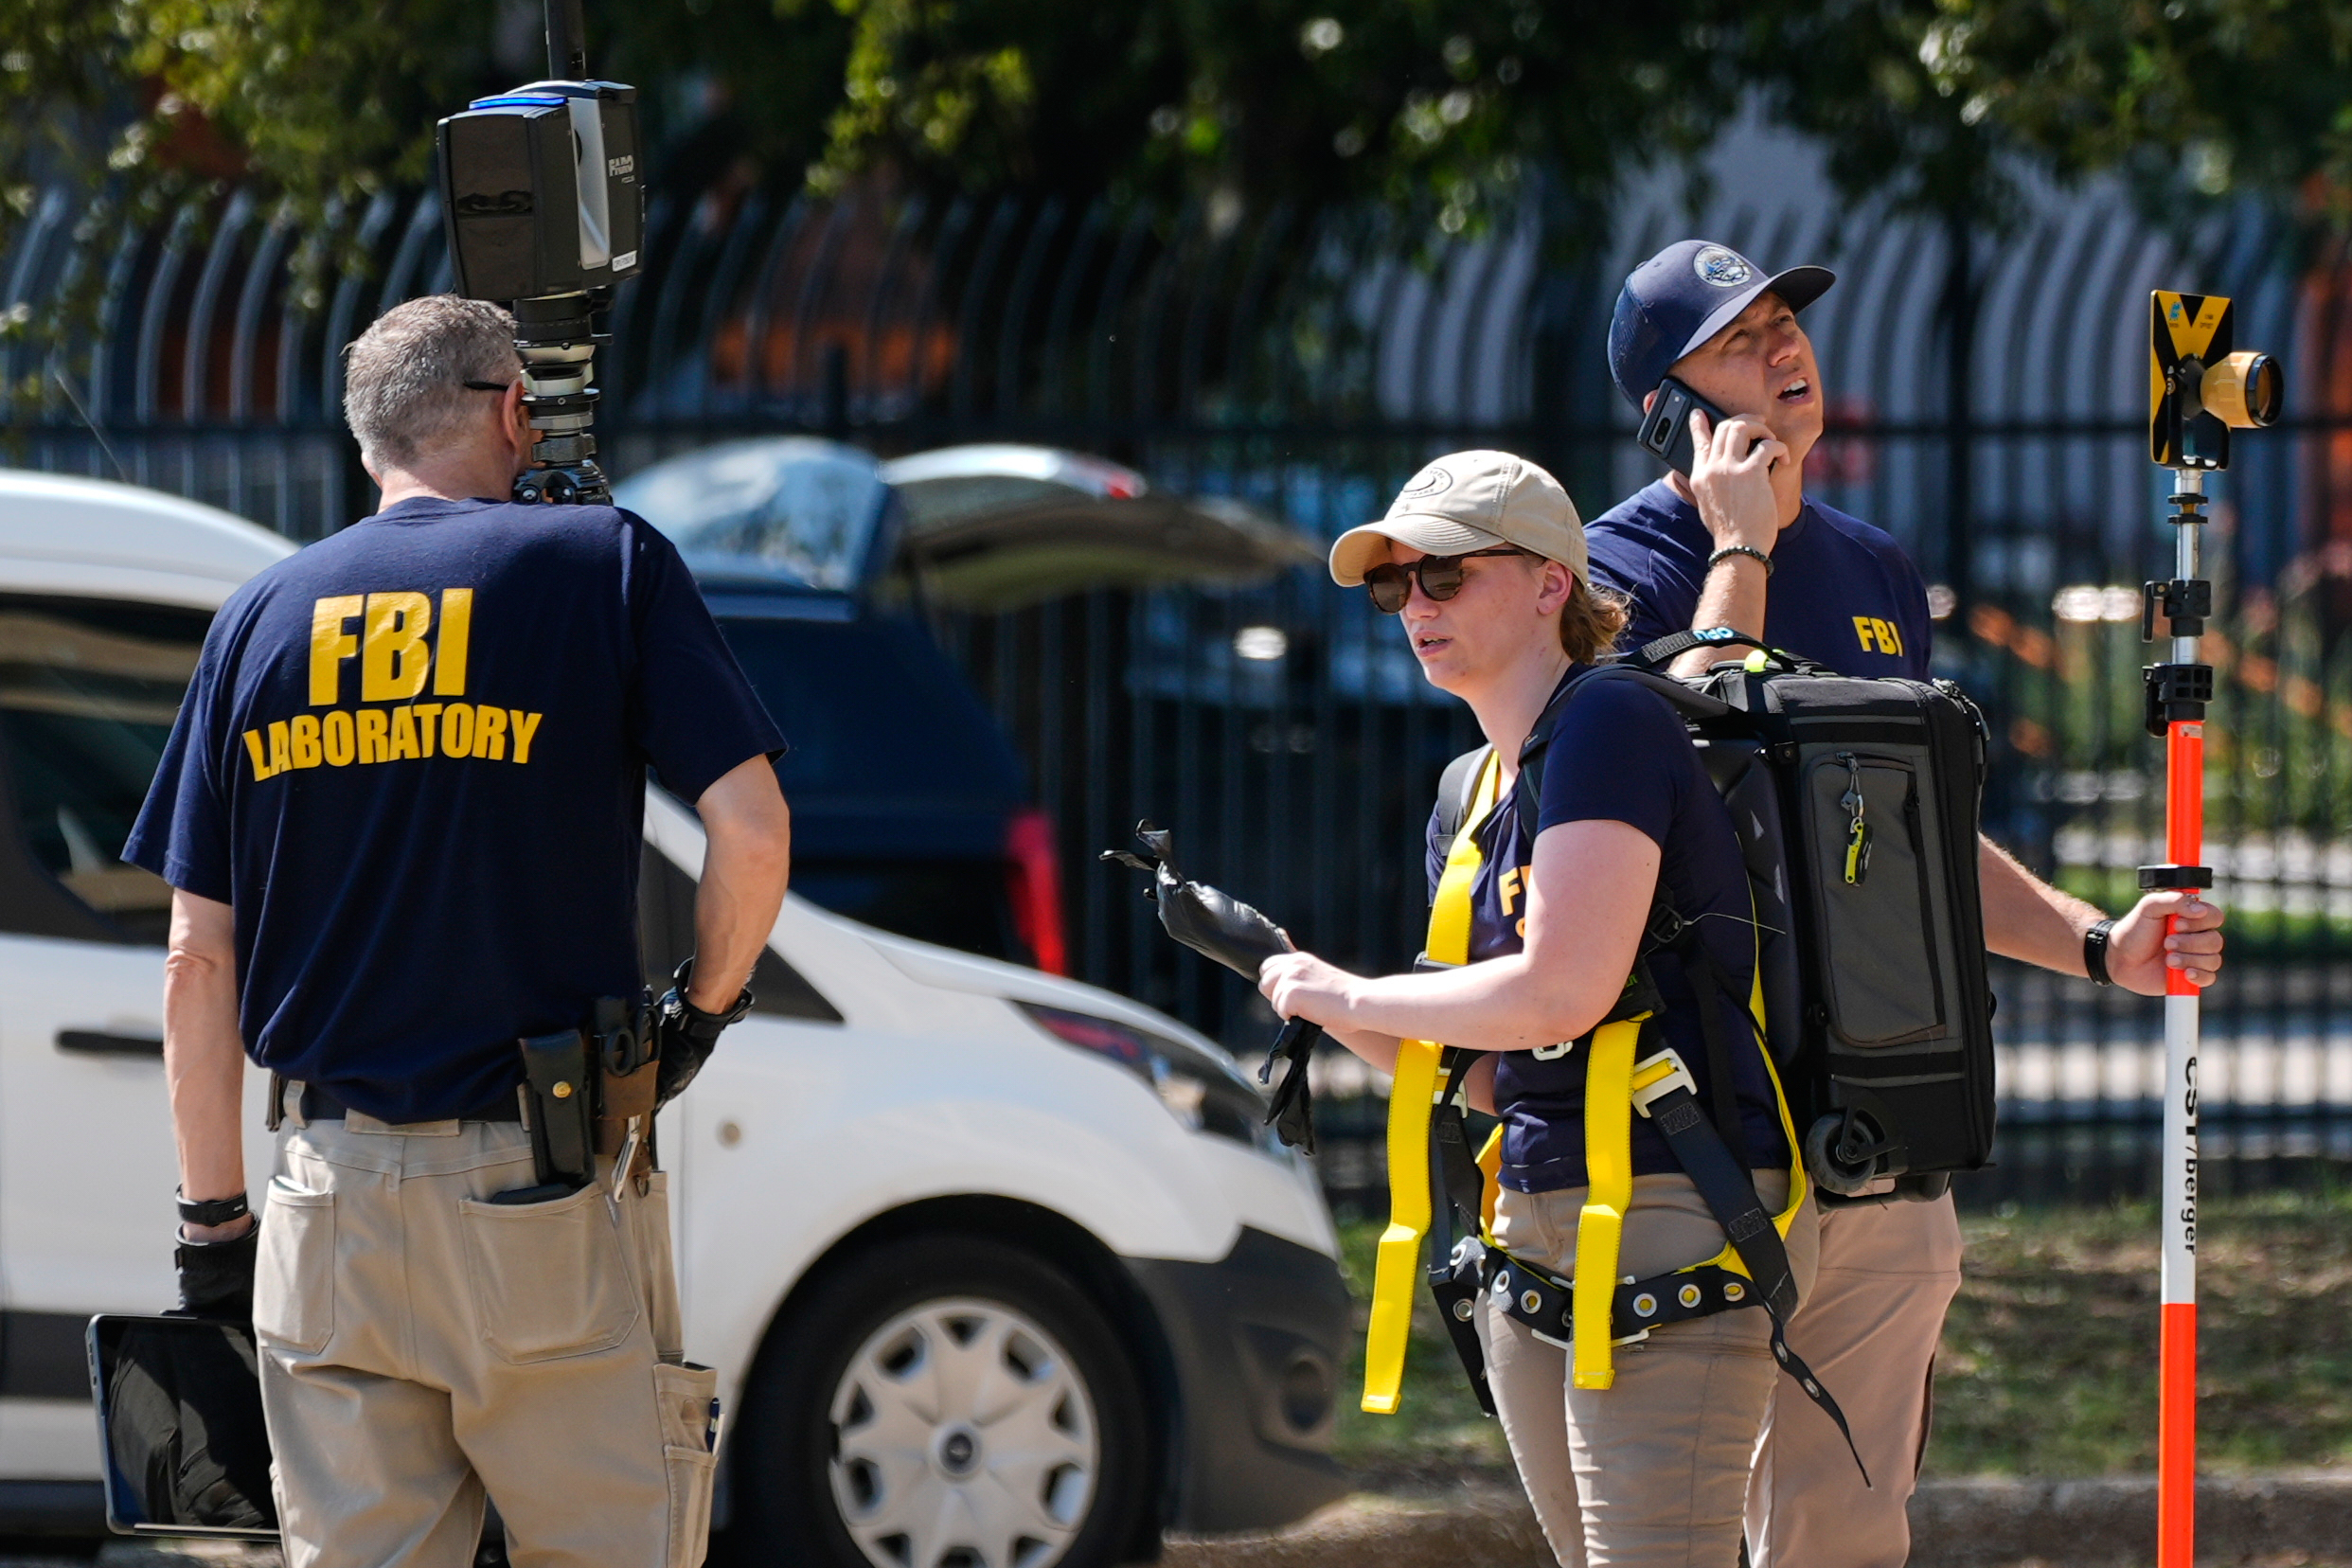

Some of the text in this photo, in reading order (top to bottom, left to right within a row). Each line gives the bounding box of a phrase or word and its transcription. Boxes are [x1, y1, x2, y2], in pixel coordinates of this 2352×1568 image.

[309, 587, 473, 706] FBI
[1852, 615, 1903, 658] FBI
[242, 703, 543, 782] LABORATORY
